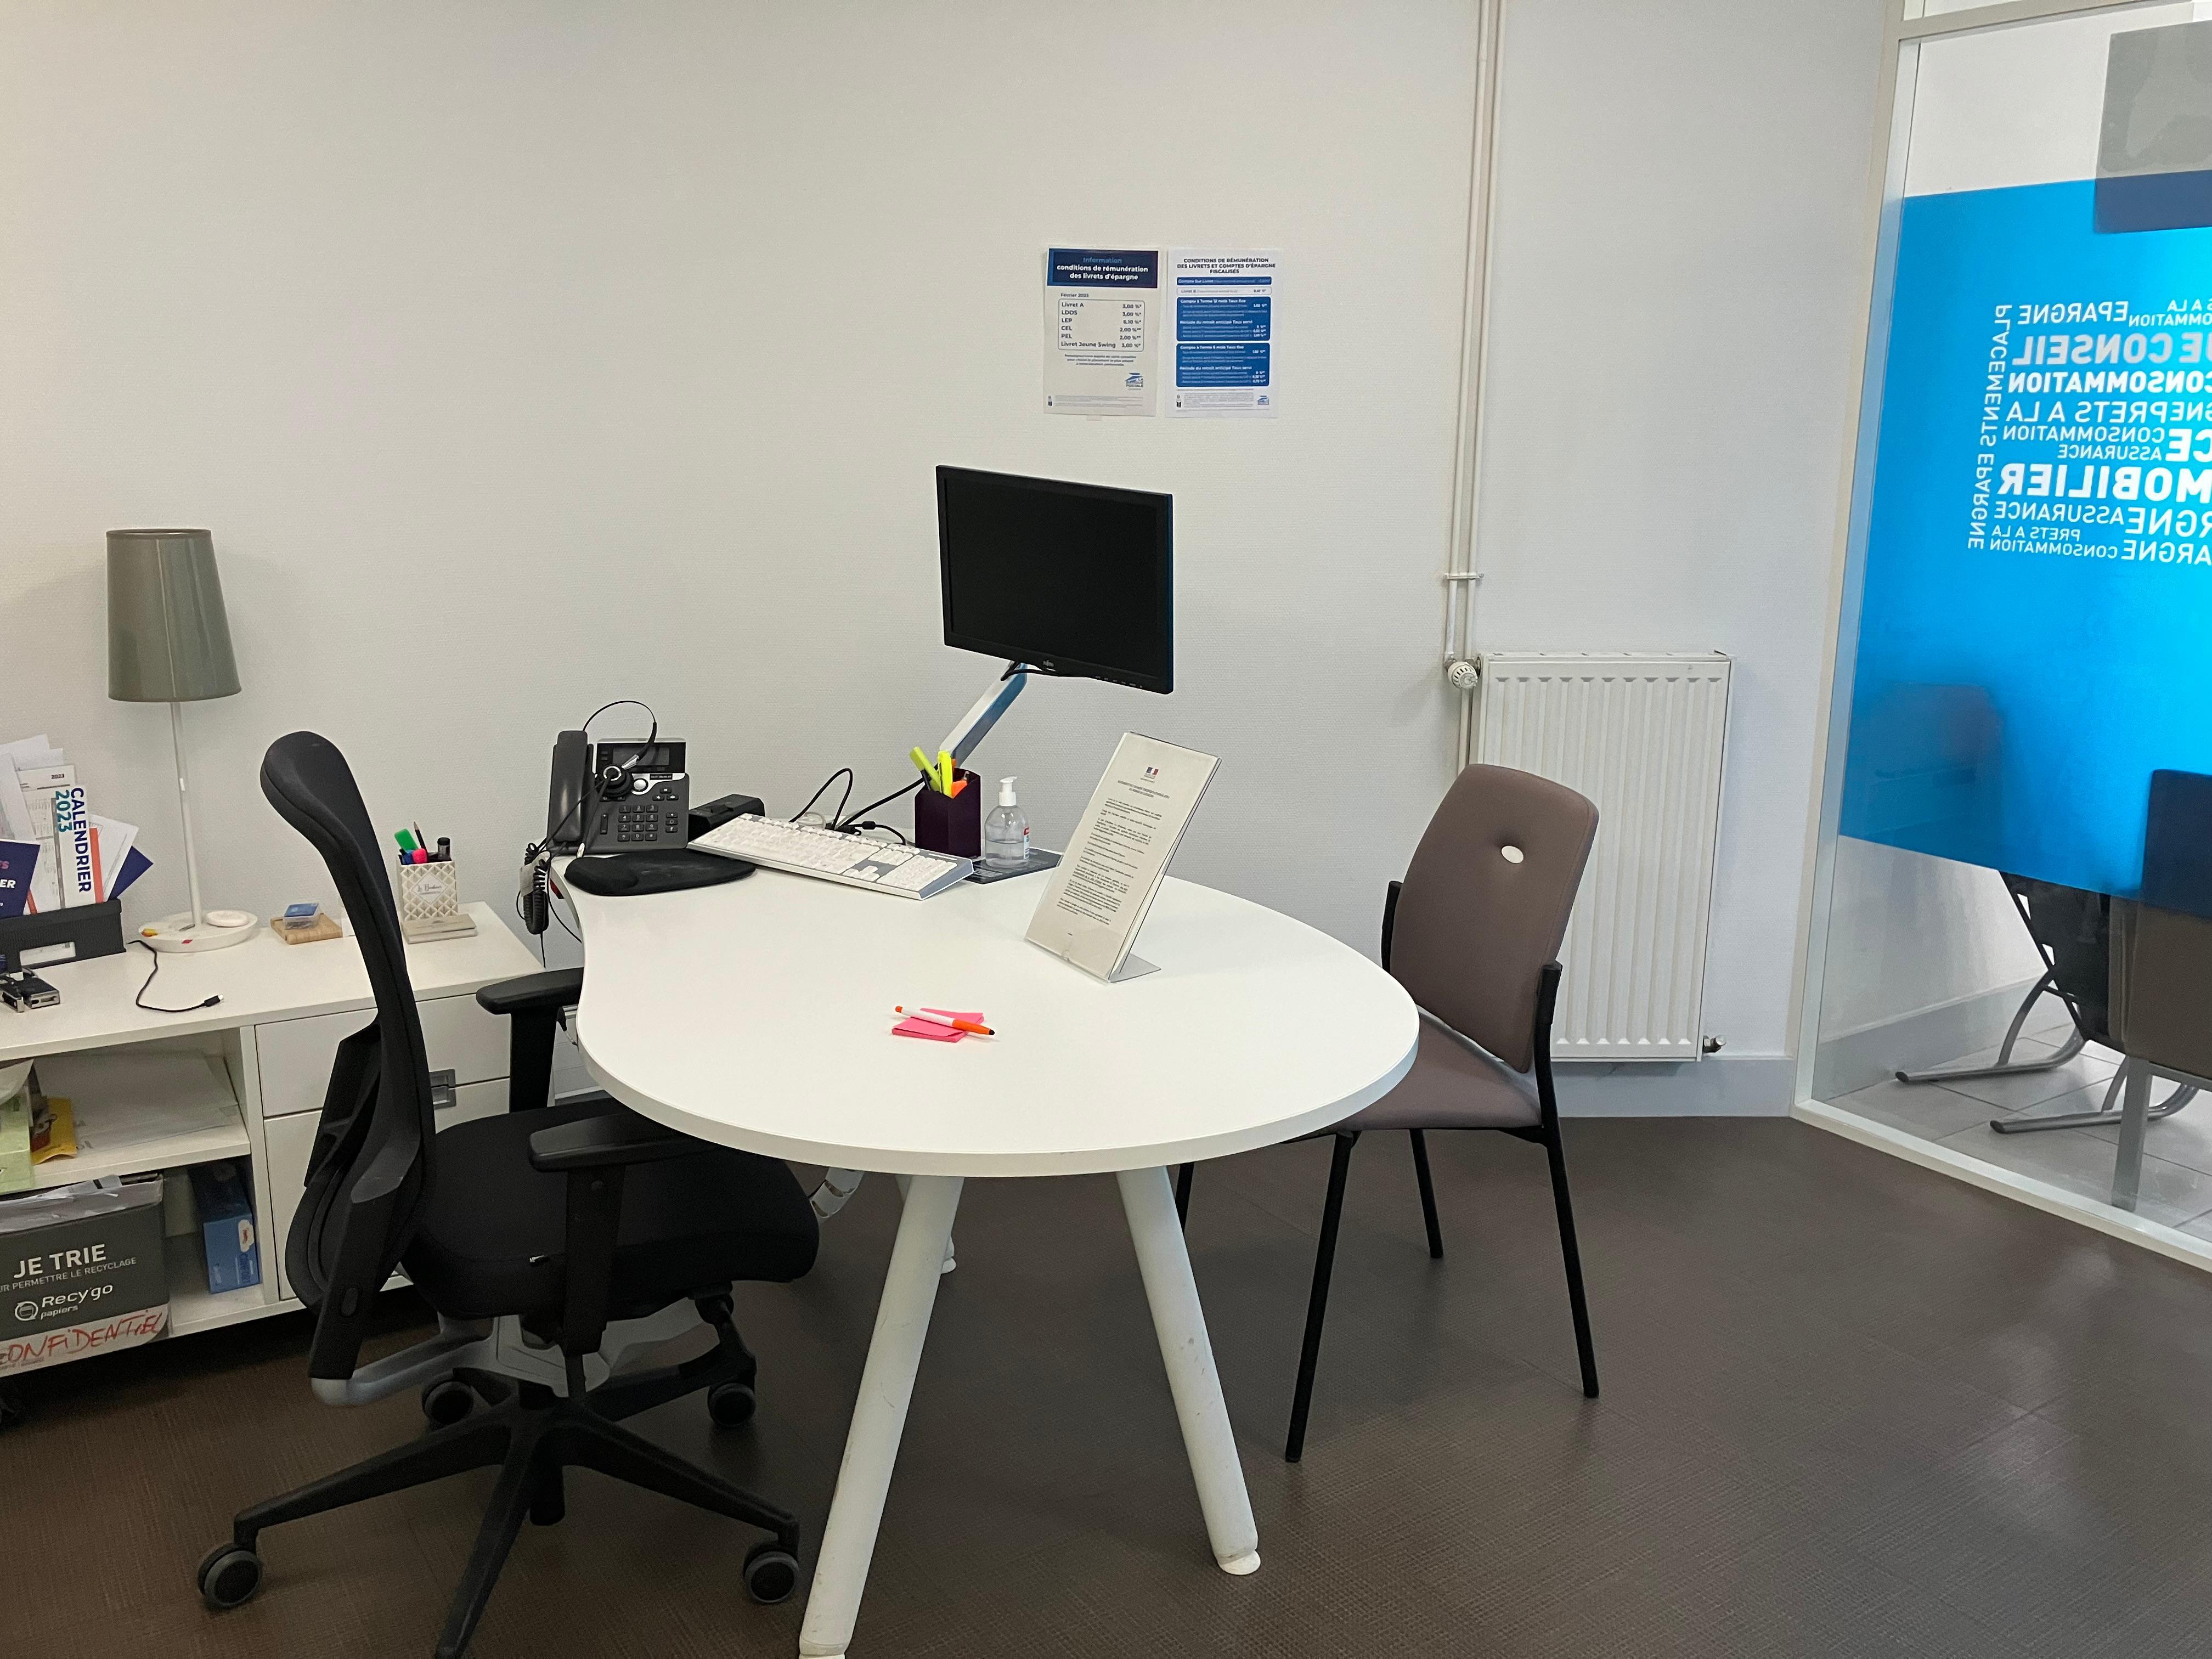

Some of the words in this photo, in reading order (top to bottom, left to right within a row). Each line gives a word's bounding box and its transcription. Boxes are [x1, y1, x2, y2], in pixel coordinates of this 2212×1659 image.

[55, 789, 74, 833] 2023
[70, 787, 92, 893] CALENDRIER
[12, 1272, 68, 1290] PERMETTRE
[70, 1270, 82, 1278] LE
[84, 1257, 137, 1275] RECYCLAGE
[14, 1257, 43, 1278] JE
[49, 1244, 106, 1270] TRIE
[41, 1304, 78, 1320] papiers
